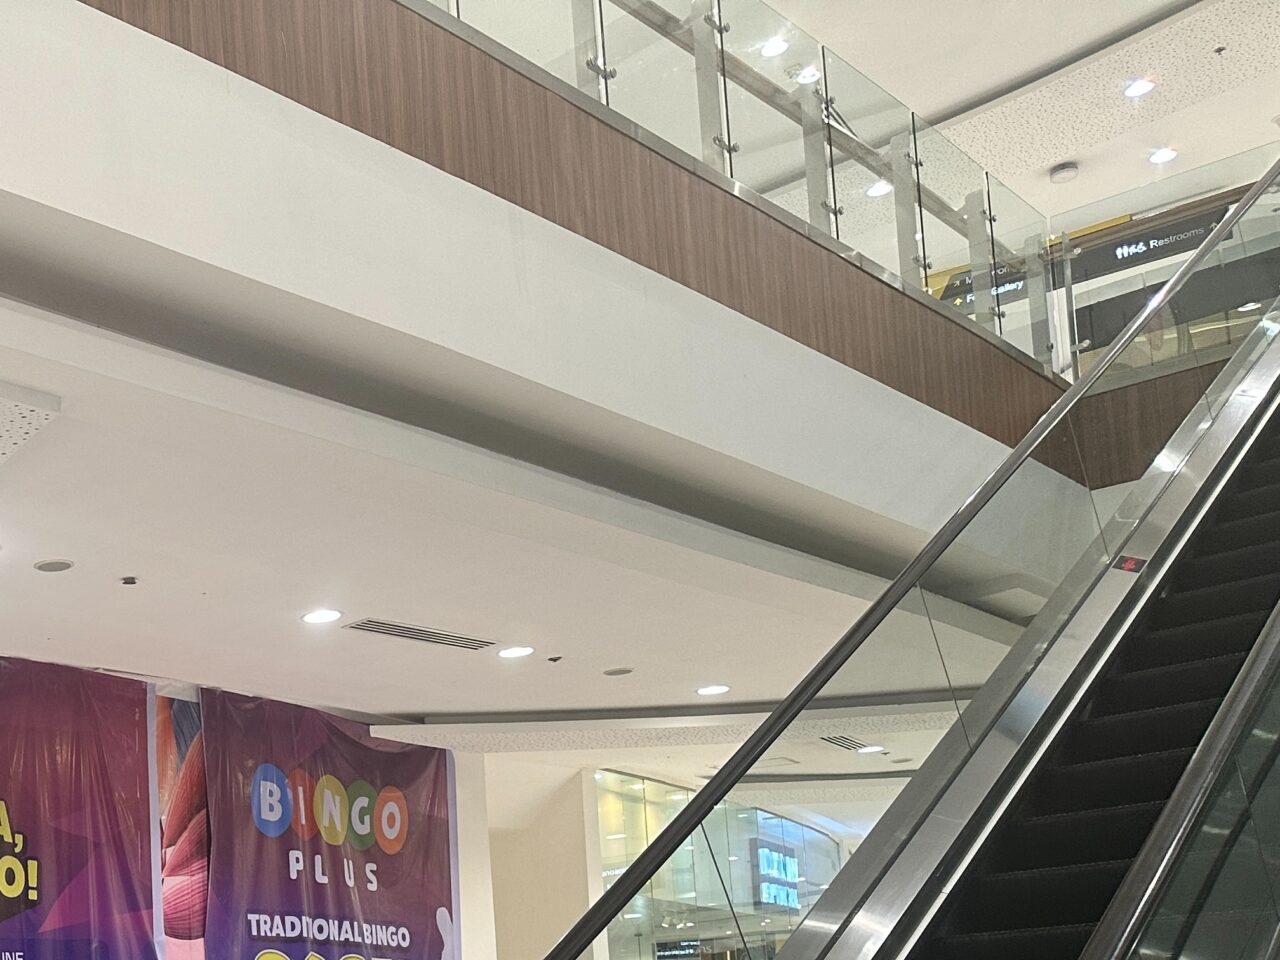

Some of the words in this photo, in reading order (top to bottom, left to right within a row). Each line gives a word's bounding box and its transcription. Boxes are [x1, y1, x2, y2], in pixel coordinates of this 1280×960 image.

[1149, 227, 1205, 249] Restrooms
[258, 777, 402, 842] BINGO
[288, 850, 378, 892] PLUS
